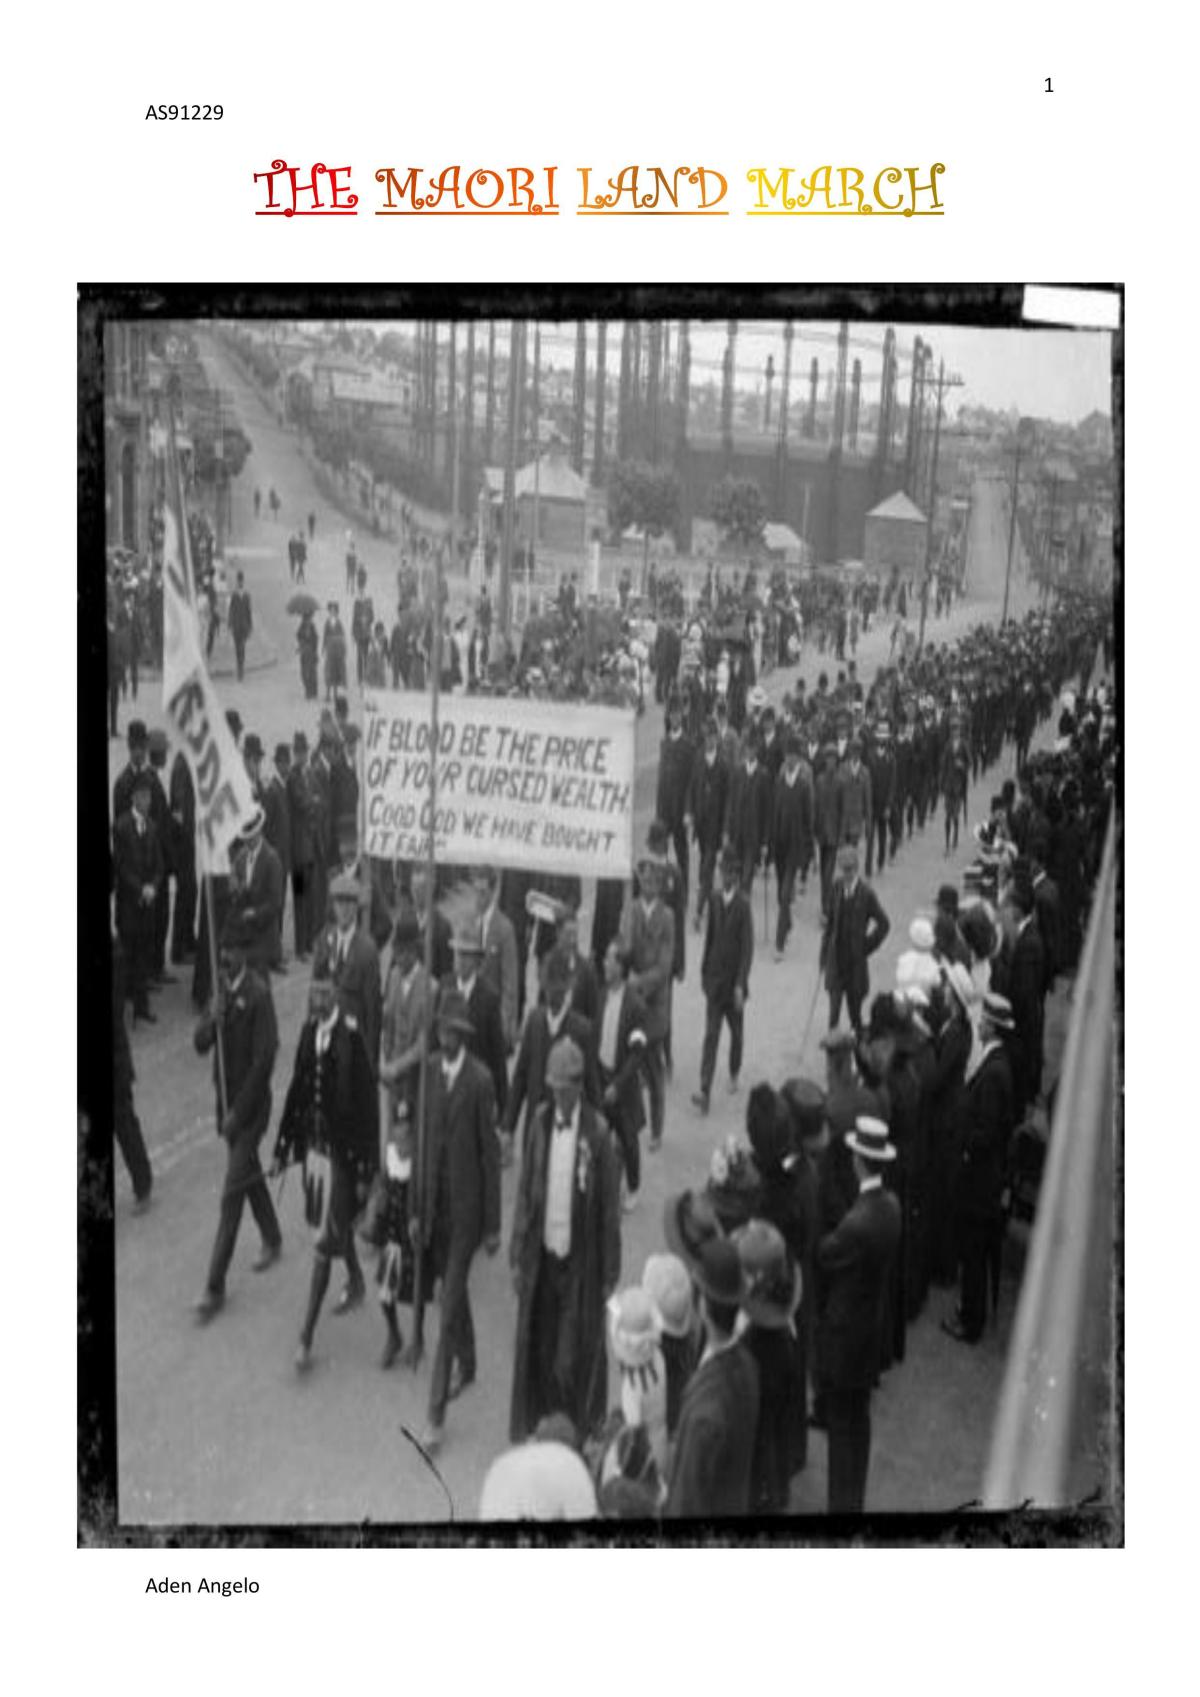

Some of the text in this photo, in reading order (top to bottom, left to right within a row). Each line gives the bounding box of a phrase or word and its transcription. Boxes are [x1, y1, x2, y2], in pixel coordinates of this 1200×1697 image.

[1045, 77, 1054, 92] 1
[145, 105, 224, 120] AS91229
[253, 159, 946, 217] THE MAORI LAND MARCH
[460, 723, 490, 757] BE
[497, 727, 541, 766] THE
[543, 736, 611, 775] PRICE
[367, 758, 397, 788] OF
[466, 765, 548, 804] CURSED
[369, 831, 393, 853] IT
[462, 810, 486, 839] WE
[490, 816, 539, 846] HAVE
[145, 1577, 259, 1597] Aden Angelo
